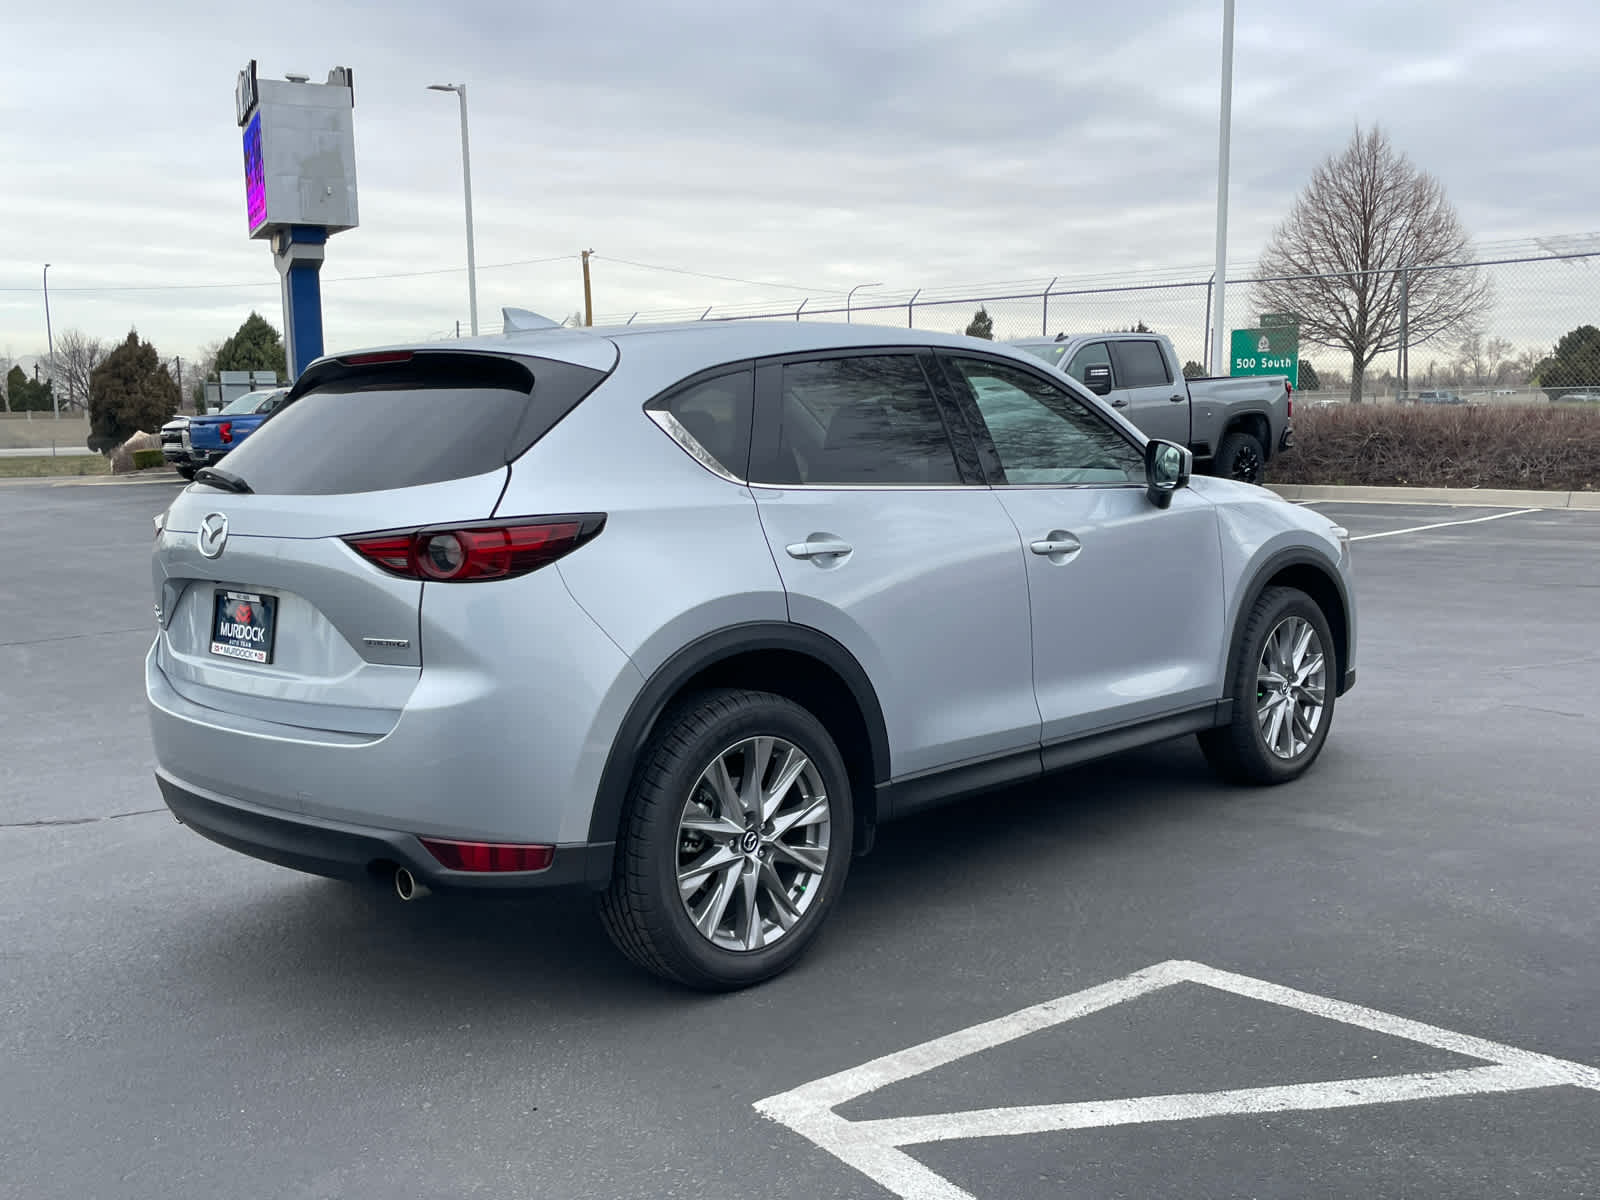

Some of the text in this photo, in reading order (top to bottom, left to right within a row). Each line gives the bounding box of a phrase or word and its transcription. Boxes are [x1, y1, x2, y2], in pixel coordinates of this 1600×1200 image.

[1236, 357, 1292, 369] 500 South
[220, 621, 265, 642] MURDOCK
[223, 646, 254, 658] MURDOCK
